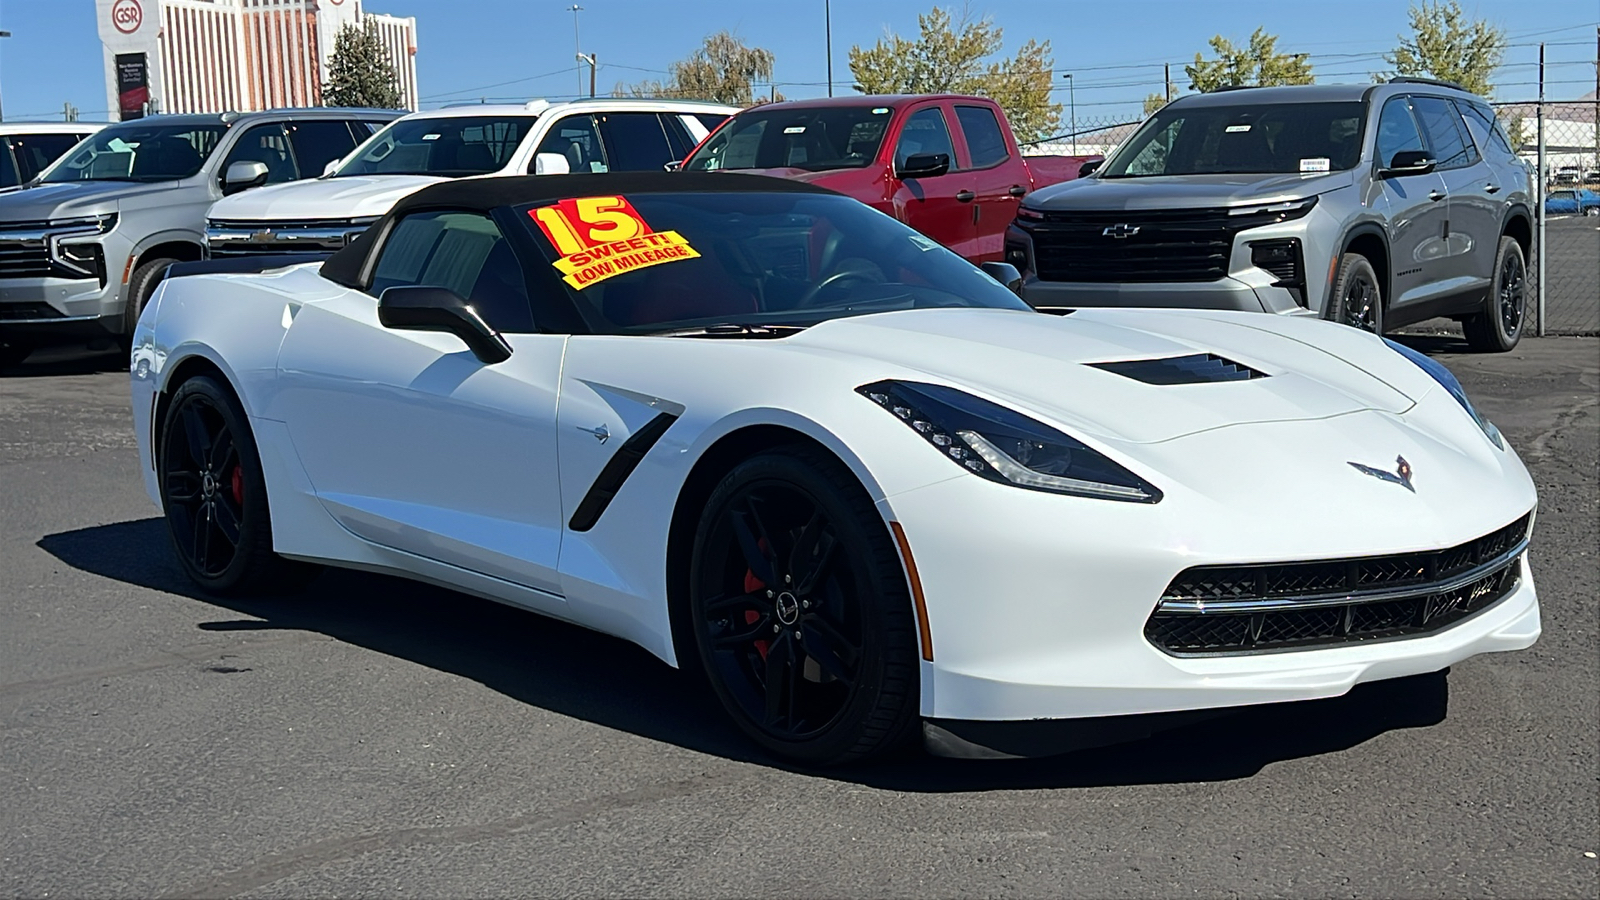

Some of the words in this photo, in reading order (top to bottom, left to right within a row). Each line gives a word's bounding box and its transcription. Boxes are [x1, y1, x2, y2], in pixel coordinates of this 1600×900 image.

[116, 7, 138, 23] GSR
[536, 197, 643, 255] 15
[569, 234, 670, 267] SWEET!
[574, 262, 614, 285] LOW
[615, 245, 690, 270] MILEAGE
